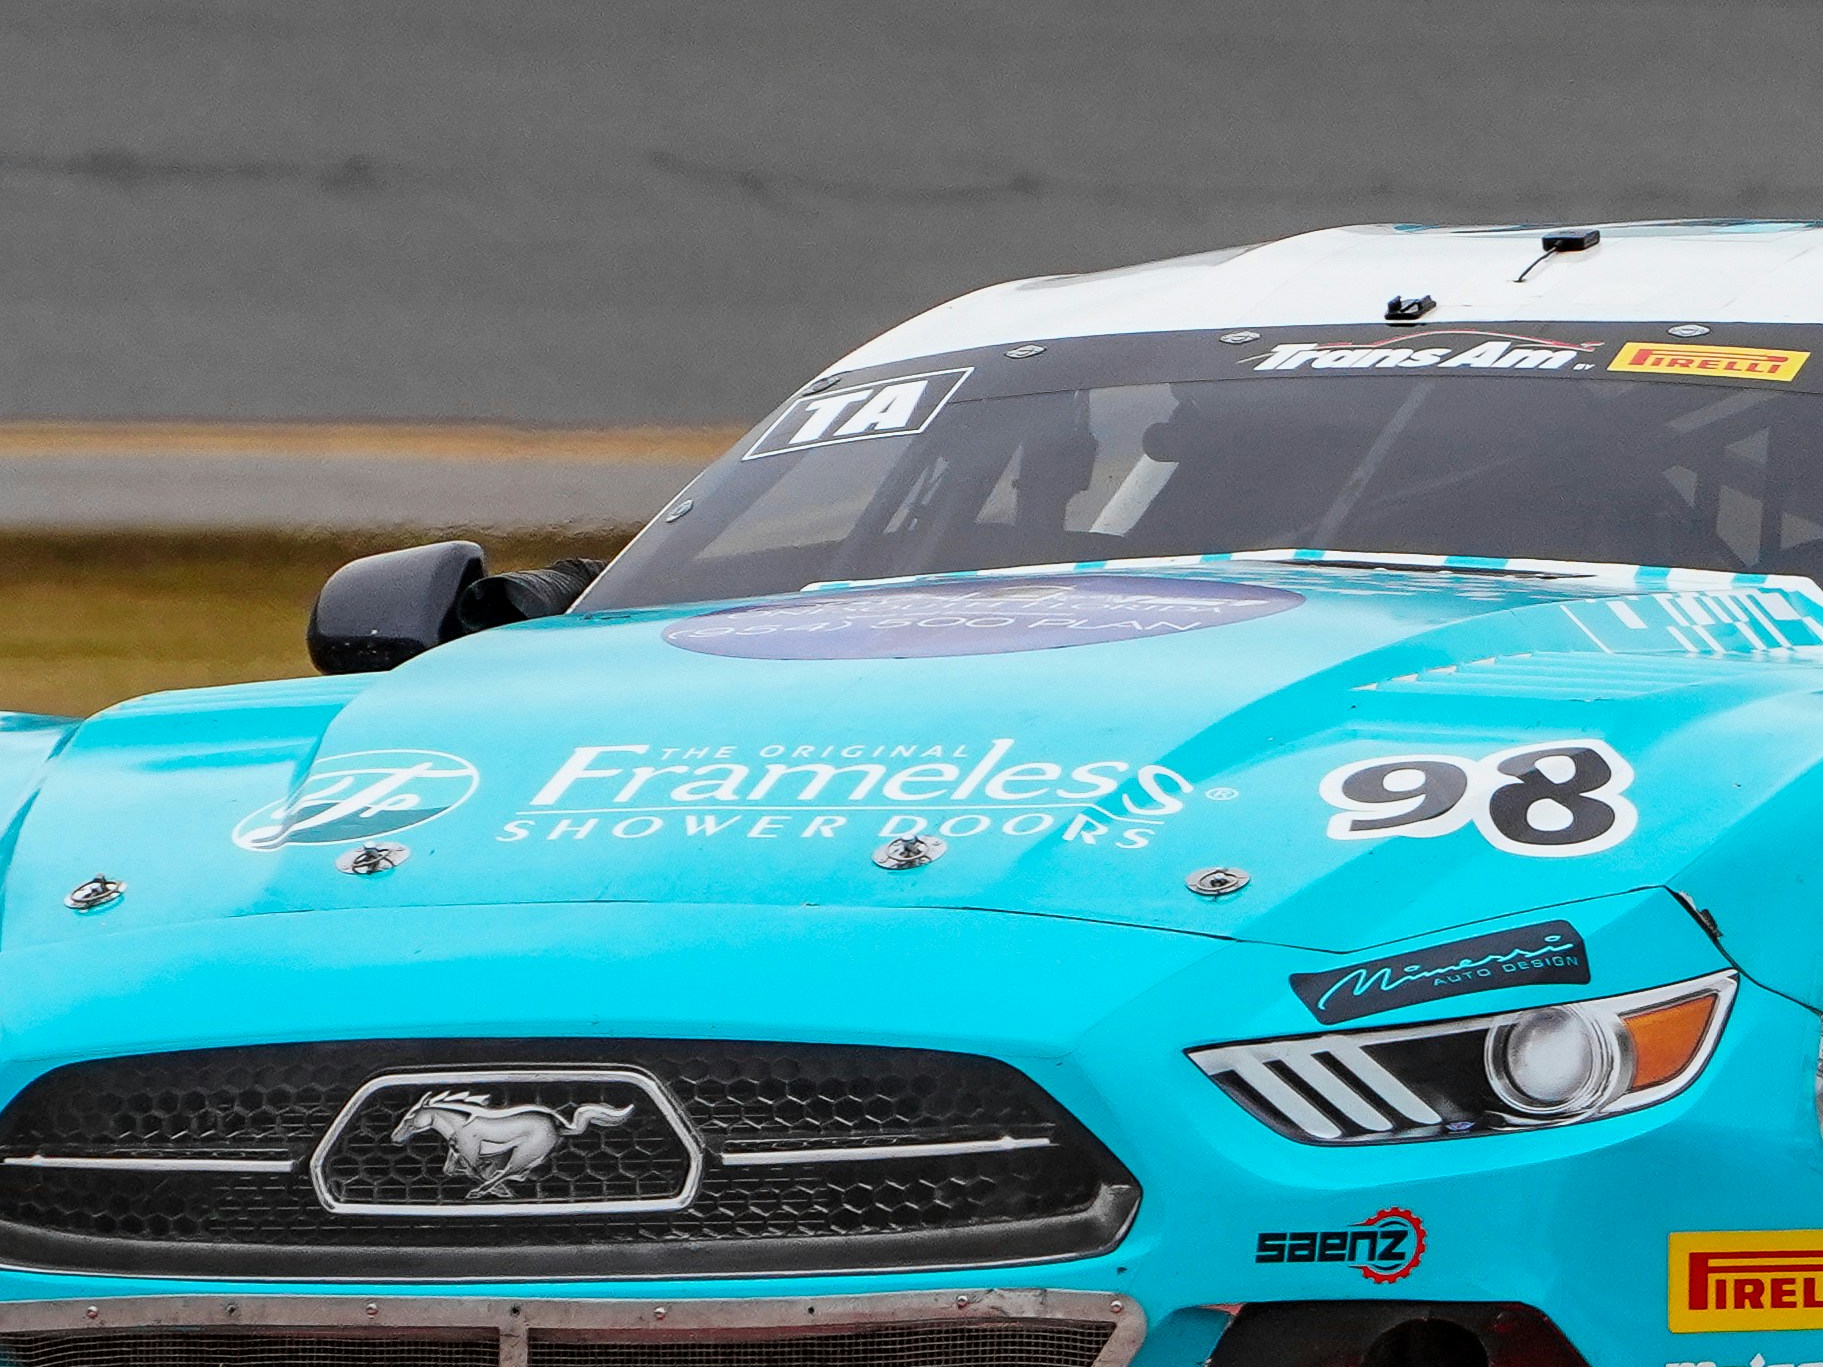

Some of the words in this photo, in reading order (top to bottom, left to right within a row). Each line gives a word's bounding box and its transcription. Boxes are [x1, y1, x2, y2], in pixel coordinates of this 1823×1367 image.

[1253, 342, 1451, 371] Trans
[1446, 341, 1580, 371] Am
[1634, 348, 1788, 375] PIRELLI
[788, 379, 928, 445] TA
[869, 617, 1014, 629] 500
[1027, 619, 1202, 631] PLAN
[660, 745, 739, 761] THE
[759, 744, 969, 759] ORIGINAL
[1340, 746, 1617, 846] 98
[495, 814, 848, 843] SHOWER
[877, 813, 1156, 850] DOORS
[1432, 968, 1492, 987] AUTO
[1502, 954, 1580, 974] DESIGN
[1255, 1230, 1409, 1264] saenz
